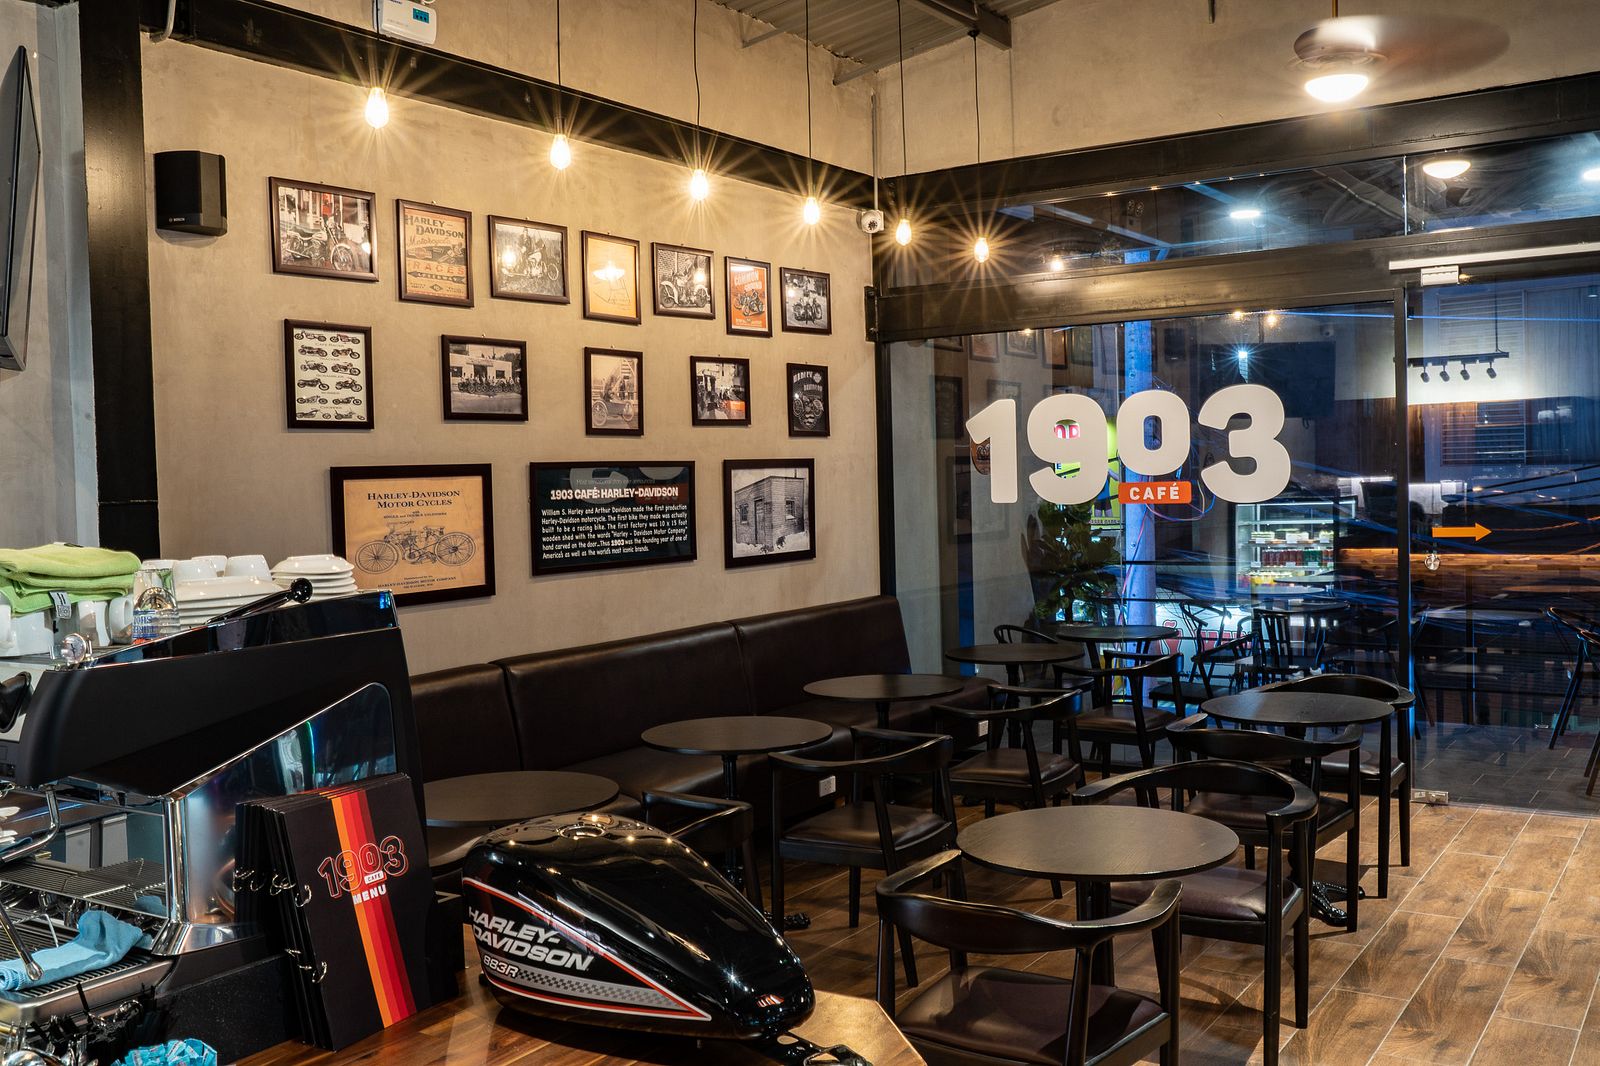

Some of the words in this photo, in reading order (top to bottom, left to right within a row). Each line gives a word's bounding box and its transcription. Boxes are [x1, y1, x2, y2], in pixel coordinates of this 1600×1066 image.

[405, 215, 445, 228] HARLEY
[416, 225, 464, 239] DAVIDSON
[412, 262, 464, 275] RACES
[966, 384, 1291, 504] 1903
[368, 490, 460, 500] HARLEY-DAVIDSON
[550, 490, 573, 500] 1903
[601, 487, 678, 499] HARLEY-DAVIDSON
[1130, 482, 1180, 500] CAFÉ
[542, 517, 580, 525] Harley-Davidson
[317, 835, 409, 898] 1903
[352, 884, 386, 904] MENU
[469, 906, 560, 944] HARLEY-
[473, 924, 594, 971] DAVIDSON
[483, 954, 518, 978] 883R
